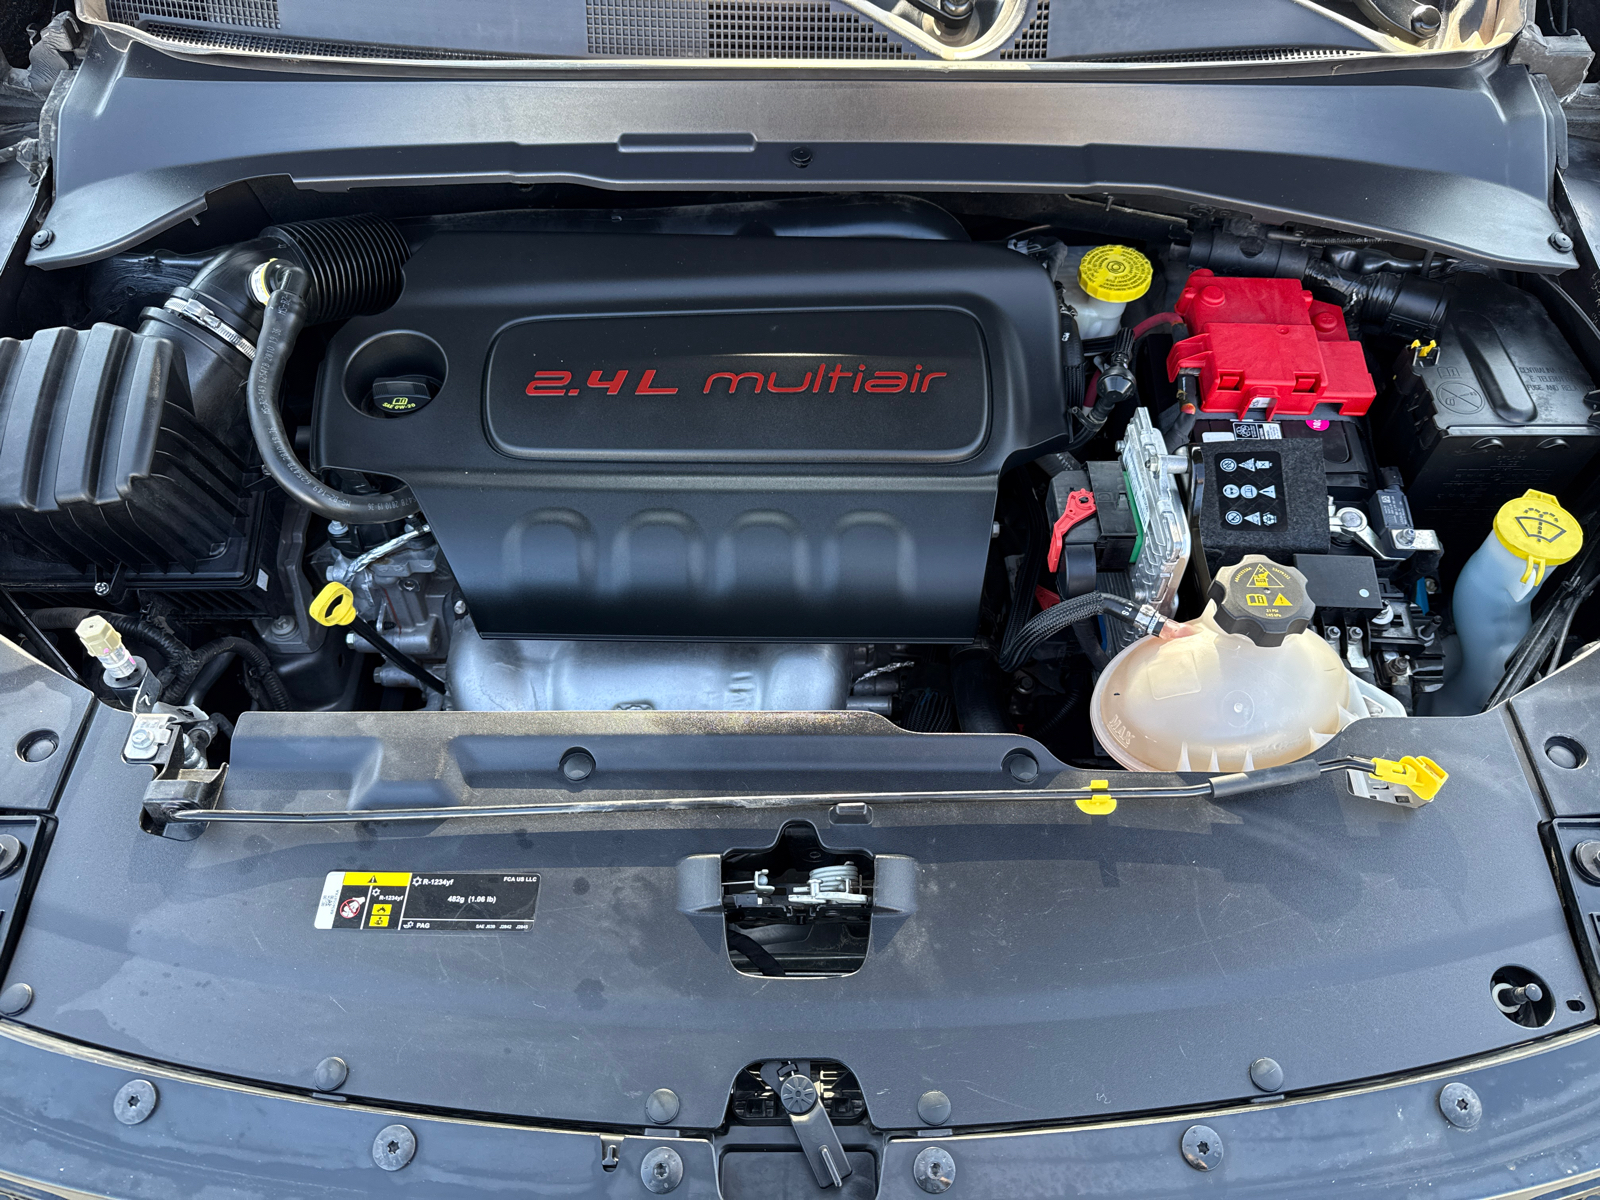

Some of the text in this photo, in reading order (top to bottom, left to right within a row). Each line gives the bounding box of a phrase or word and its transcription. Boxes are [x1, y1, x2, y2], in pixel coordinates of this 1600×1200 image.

[703, 362, 948, 394] multiair
[422, 878, 454, 887] R-1234yf
[447, 895, 465, 904] 482g
[486, 895, 497, 904] lb)
